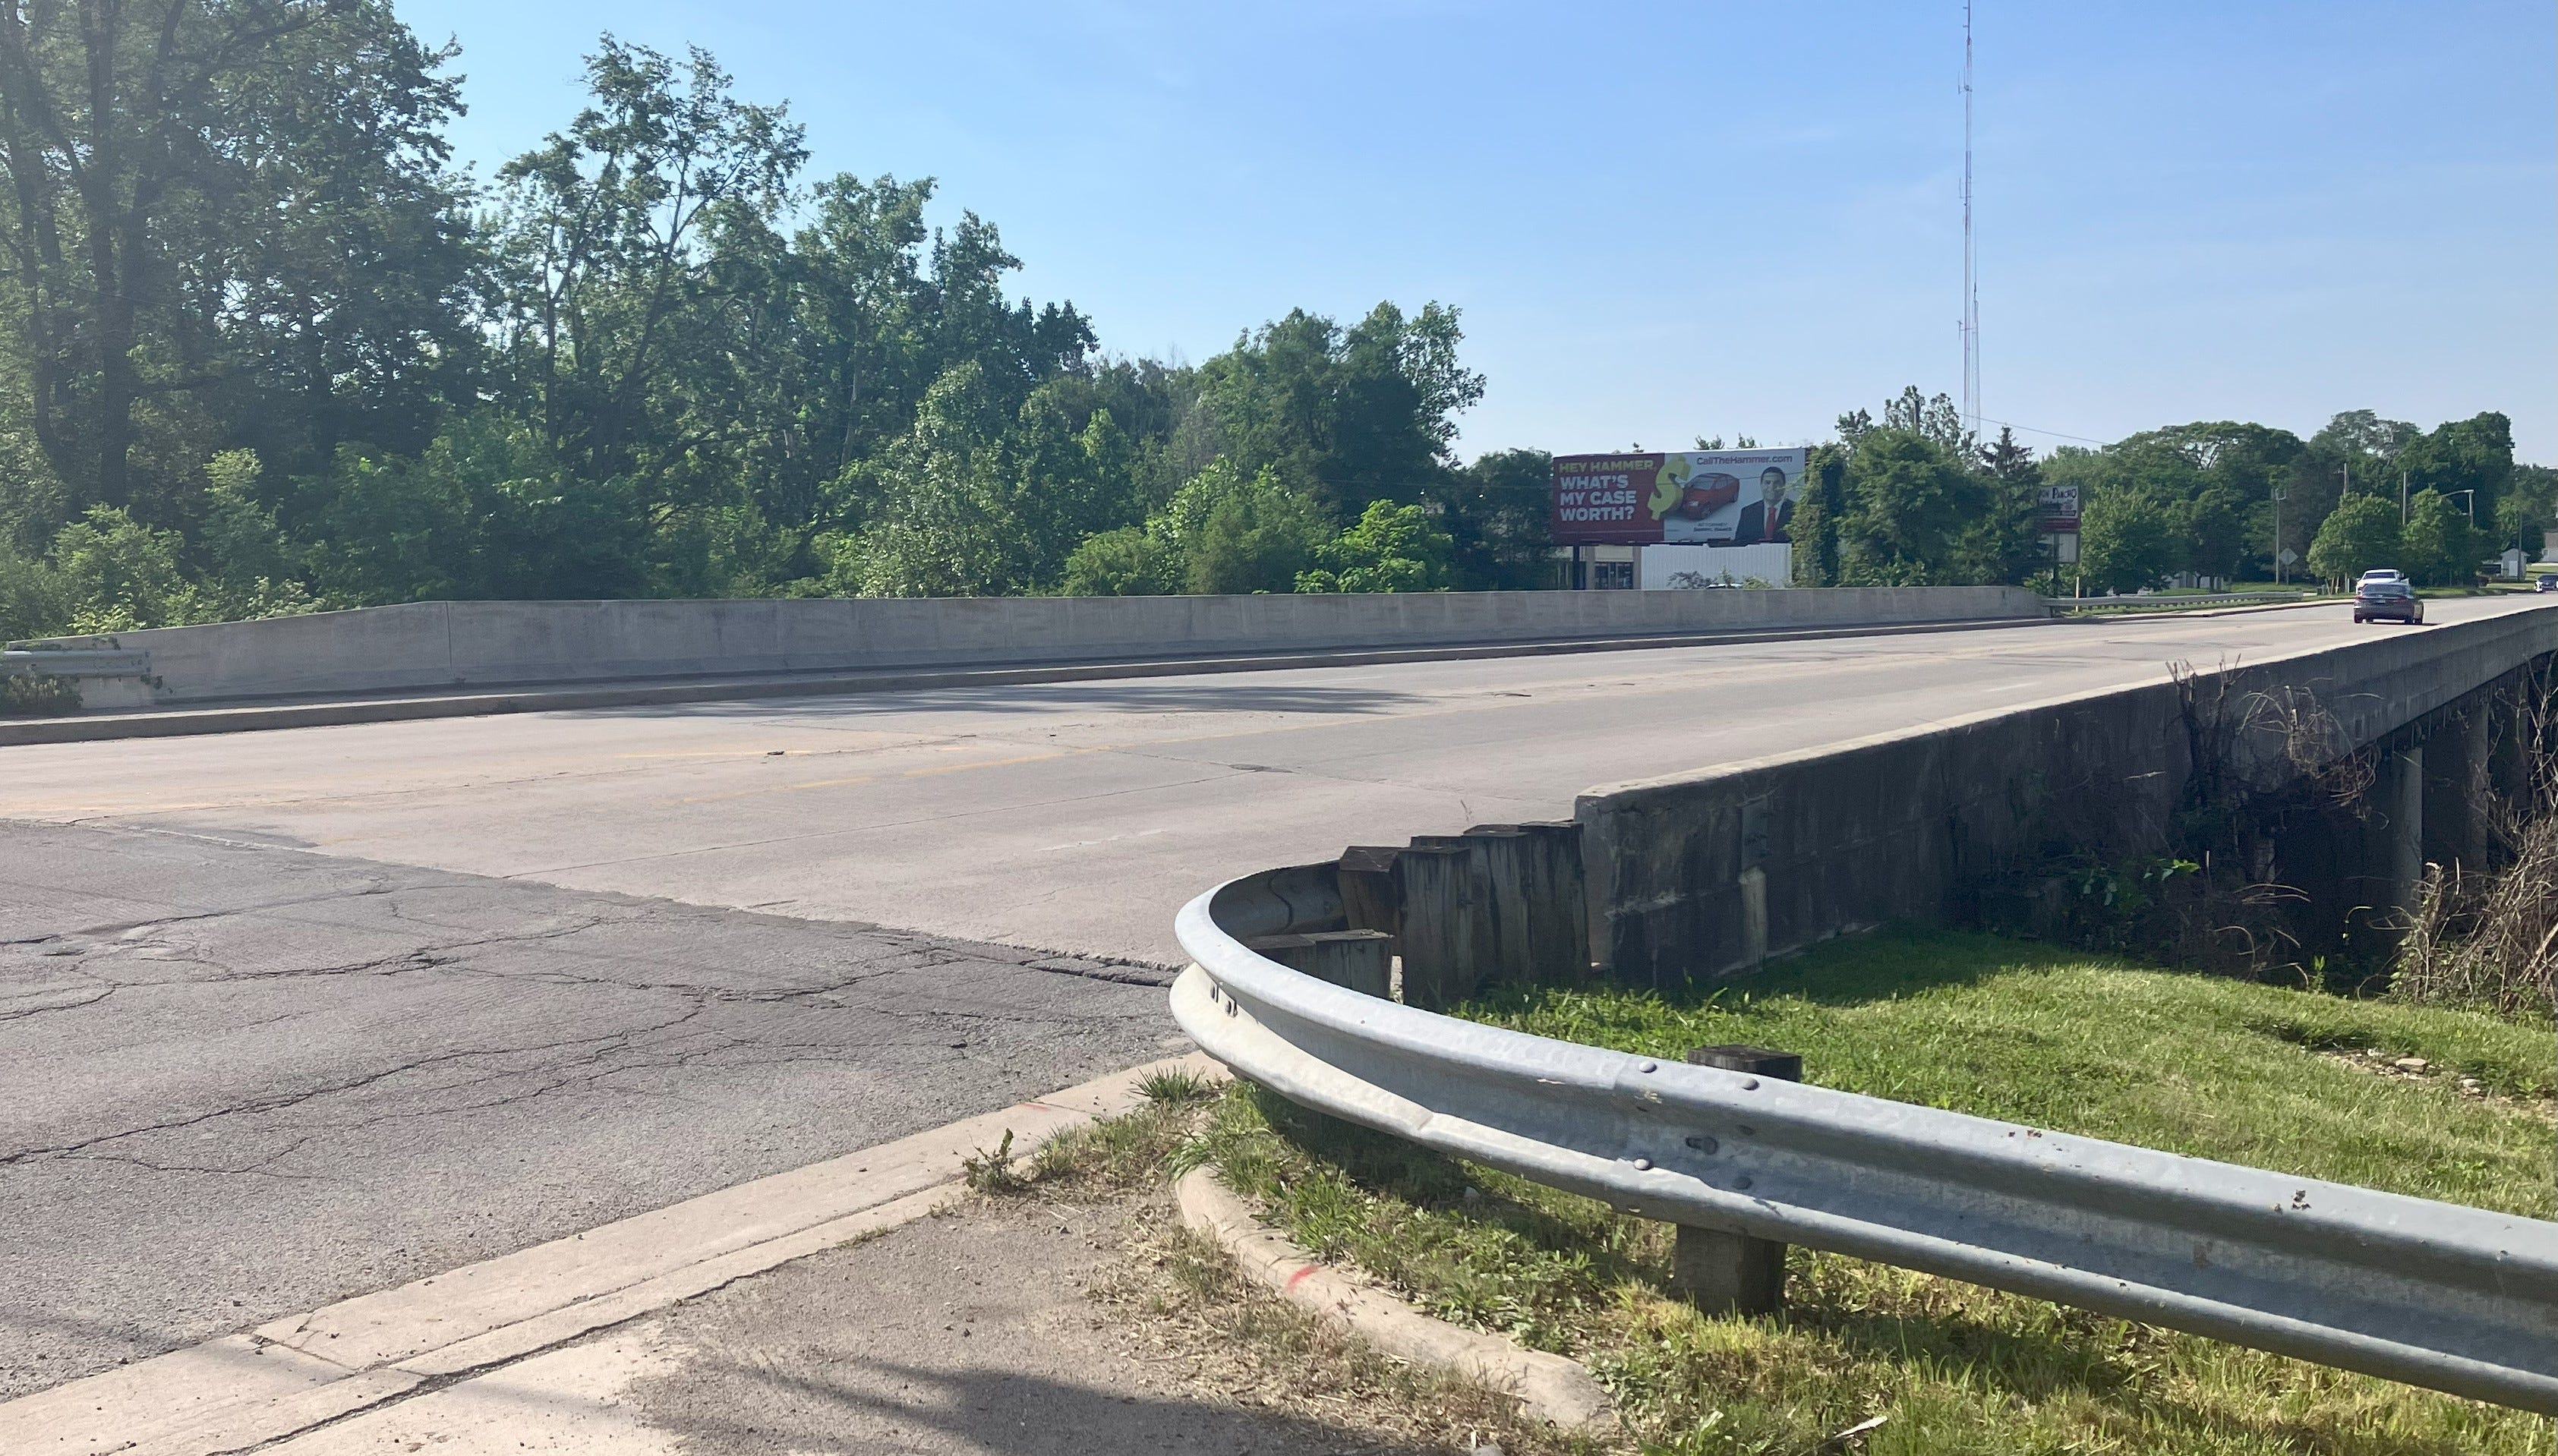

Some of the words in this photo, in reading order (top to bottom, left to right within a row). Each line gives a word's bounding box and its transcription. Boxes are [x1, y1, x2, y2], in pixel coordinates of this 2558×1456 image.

[1559, 462, 1588, 473] HEY
[1697, 455, 1793, 465] CallTheHammer.com
[1560, 474, 1629, 490] WHAT'S
[1560, 492, 1586, 506] MY
[1590, 490, 1637, 505] CASE
[1560, 506, 1635, 522] WORTH?
